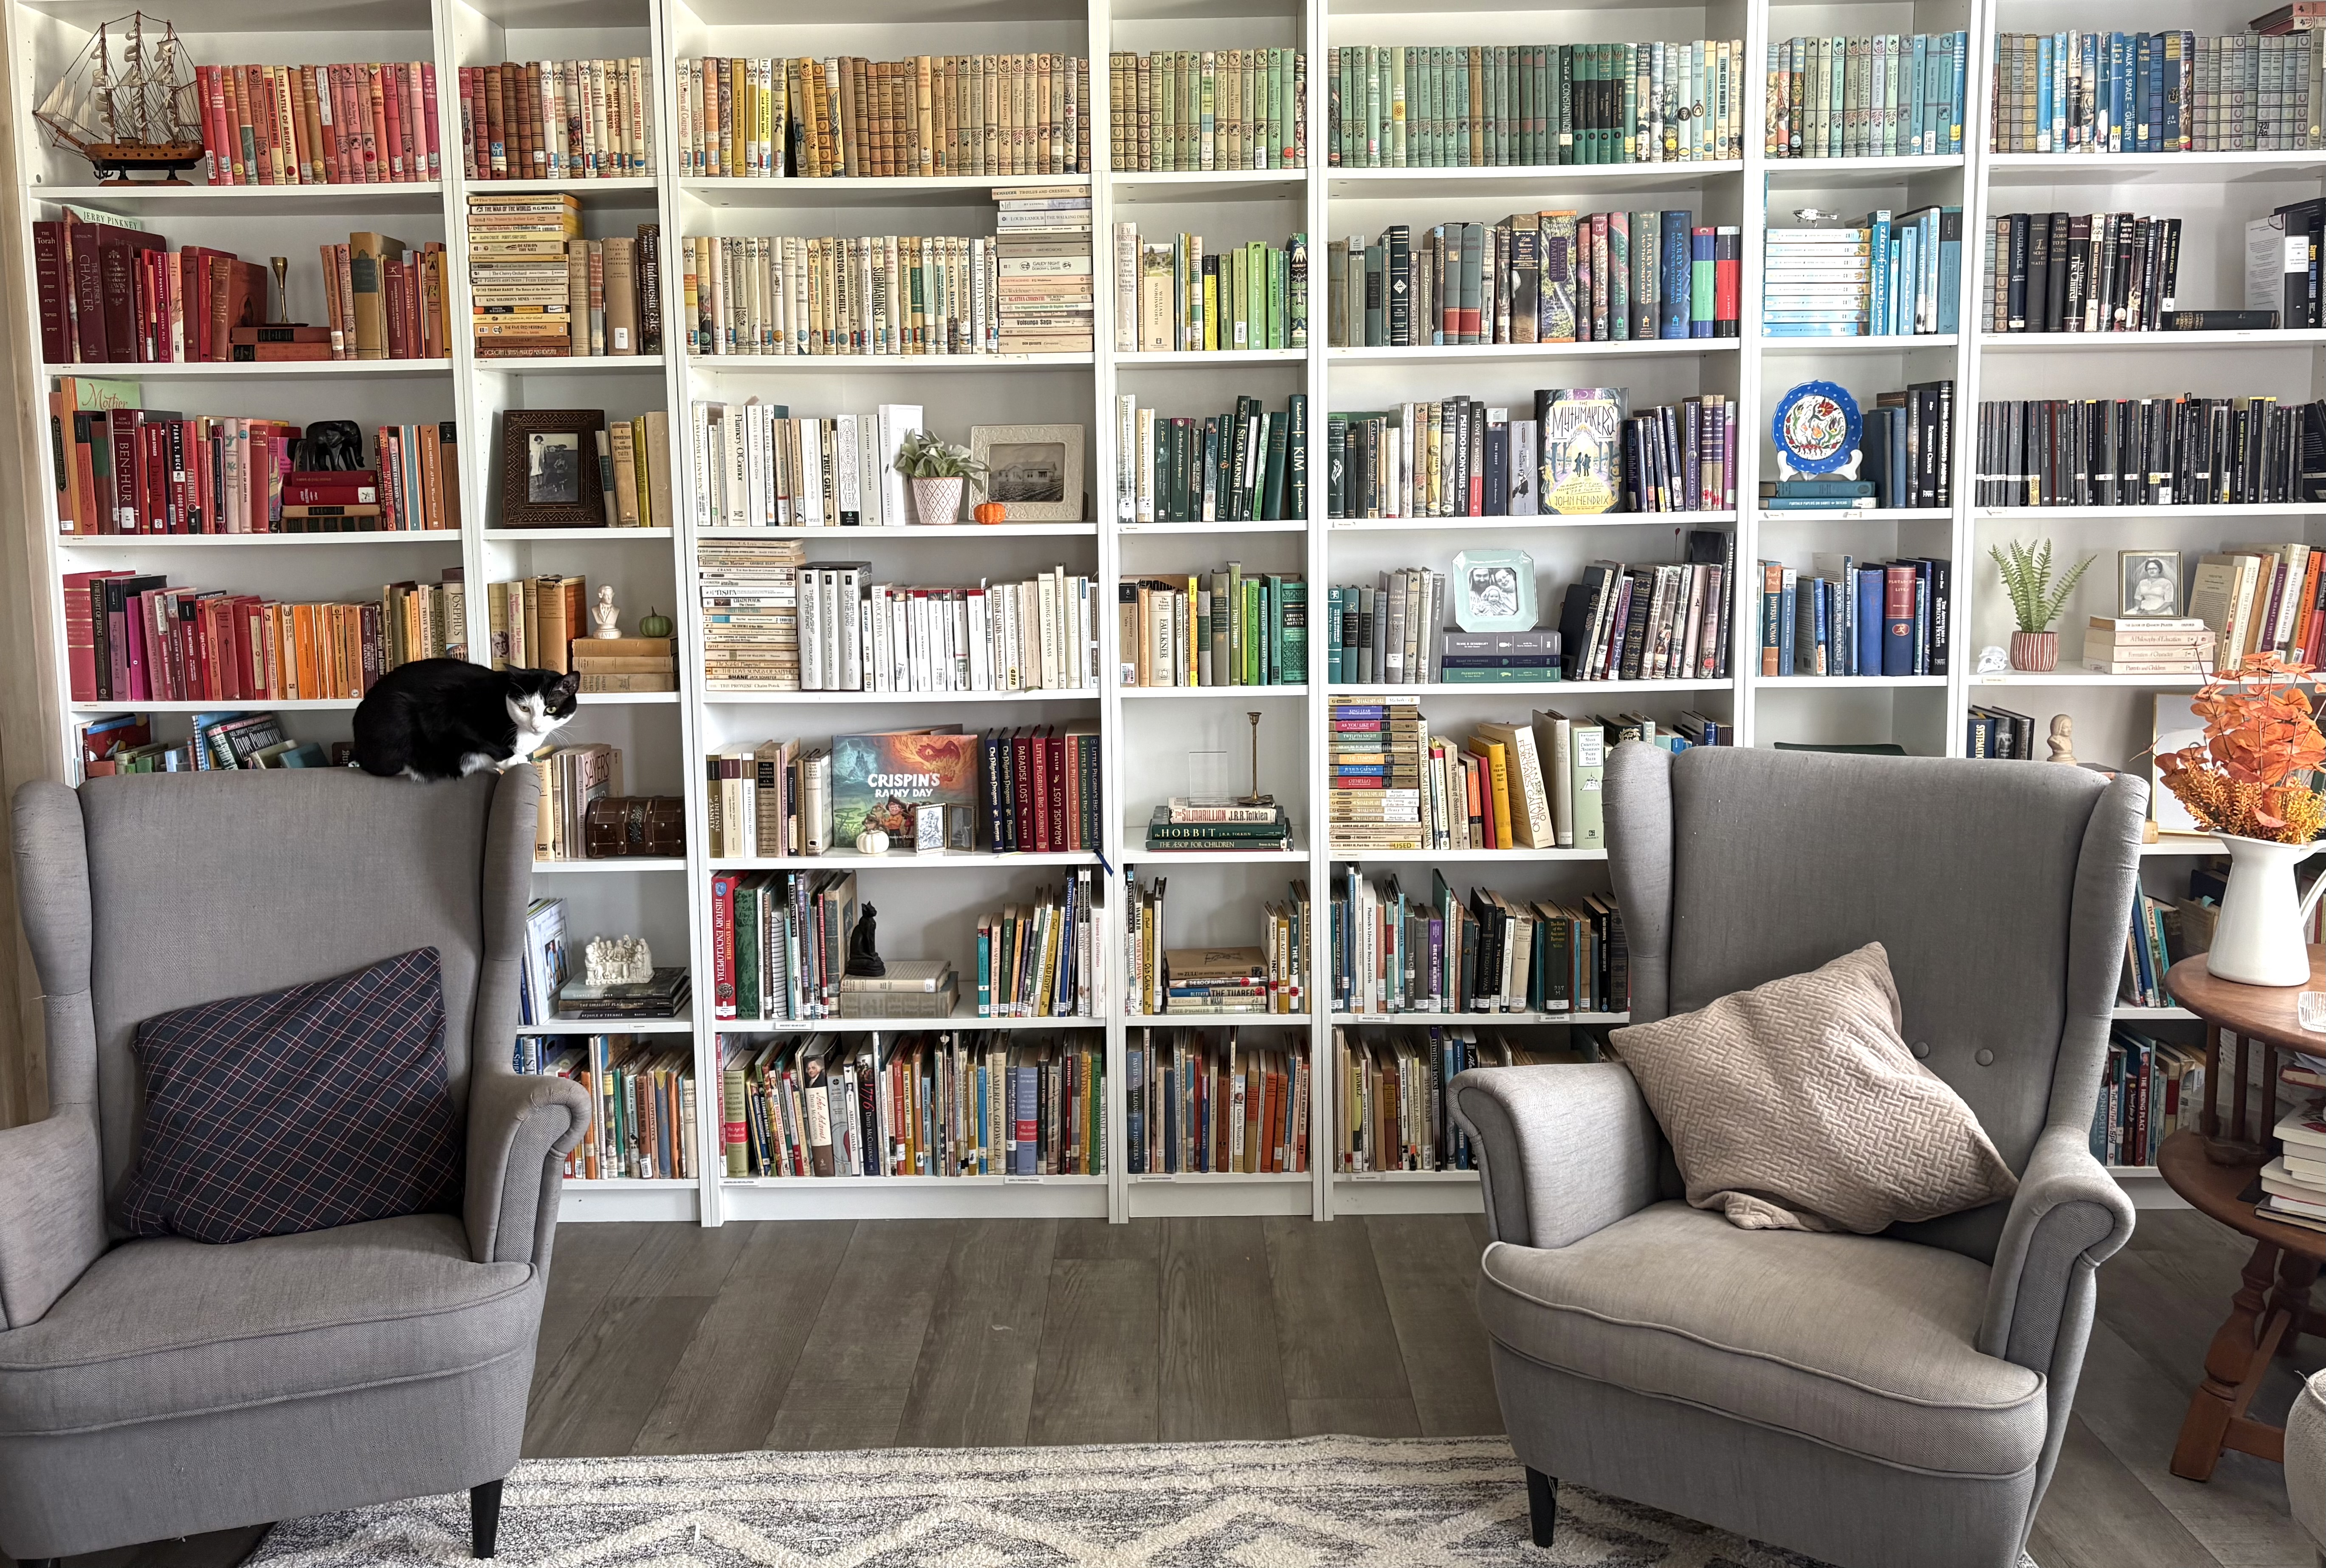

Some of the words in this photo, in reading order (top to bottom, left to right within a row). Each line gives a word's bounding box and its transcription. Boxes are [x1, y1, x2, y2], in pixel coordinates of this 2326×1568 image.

[2126, 45, 2134, 67] WALK
[2126, 69, 2132, 77] IN
[279, 89, 287, 114] BATTLE
[680, 82, 688, 103] Women
[282, 116, 288, 125] OF
[680, 113, 689, 138] Courage
[283, 127, 291, 154] BRITAIN
[84, 211, 104, 222] JERRY
[107, 216, 138, 230] PINKNEY
[835, 241, 844, 273] WINSTON
[2071, 254, 2080, 271] The
[79, 255, 93, 312] CHAUCER
[647, 262, 657, 308] Indonesia
[837, 275, 845, 314] CHURCHILL
[873, 267, 885, 316] SUBMARINES
[2069, 272, 2078, 301] Church
[976, 279, 985, 327] ODYSSEY
[82, 384, 127, 410] Mother
[733, 415, 743, 446] Flannery
[1474, 438, 1480, 446] OF
[736, 448, 745, 482] O'Connor
[1294, 447, 1304, 471] KIM
[118, 443, 131, 502] BEN-HUR
[152, 465, 162, 501] Dracula
[186, 468, 195, 502] FAHRENHEIT
[823, 477, 832, 499] GRIT
[1555, 496, 1574, 506] JOHN
[1576, 495, 1609, 505] HENDRIX
[451, 593, 463, 636] JOSEPHUS
[585, 752, 611, 781] SAYERS
[868, 772, 940, 787] CRISPIN'S
[875, 789, 909, 798] RAINY
[913, 789, 933, 797] DAY
[1182, 809, 1226, 821] SILMARILLION
[1525, 790, 1540, 832] CALVINO
[1535, 798, 1546, 821] ITALO
[1162, 829, 1215, 837] HOBBIT
[715, 899, 723, 929] HISTORY
[716, 931, 725, 981] ENCYCLOPEDIA
[816, 1093, 826, 1110] John
[860, 1083, 874, 1111] 1776
[994, 1148, 1000, 1159] UP
